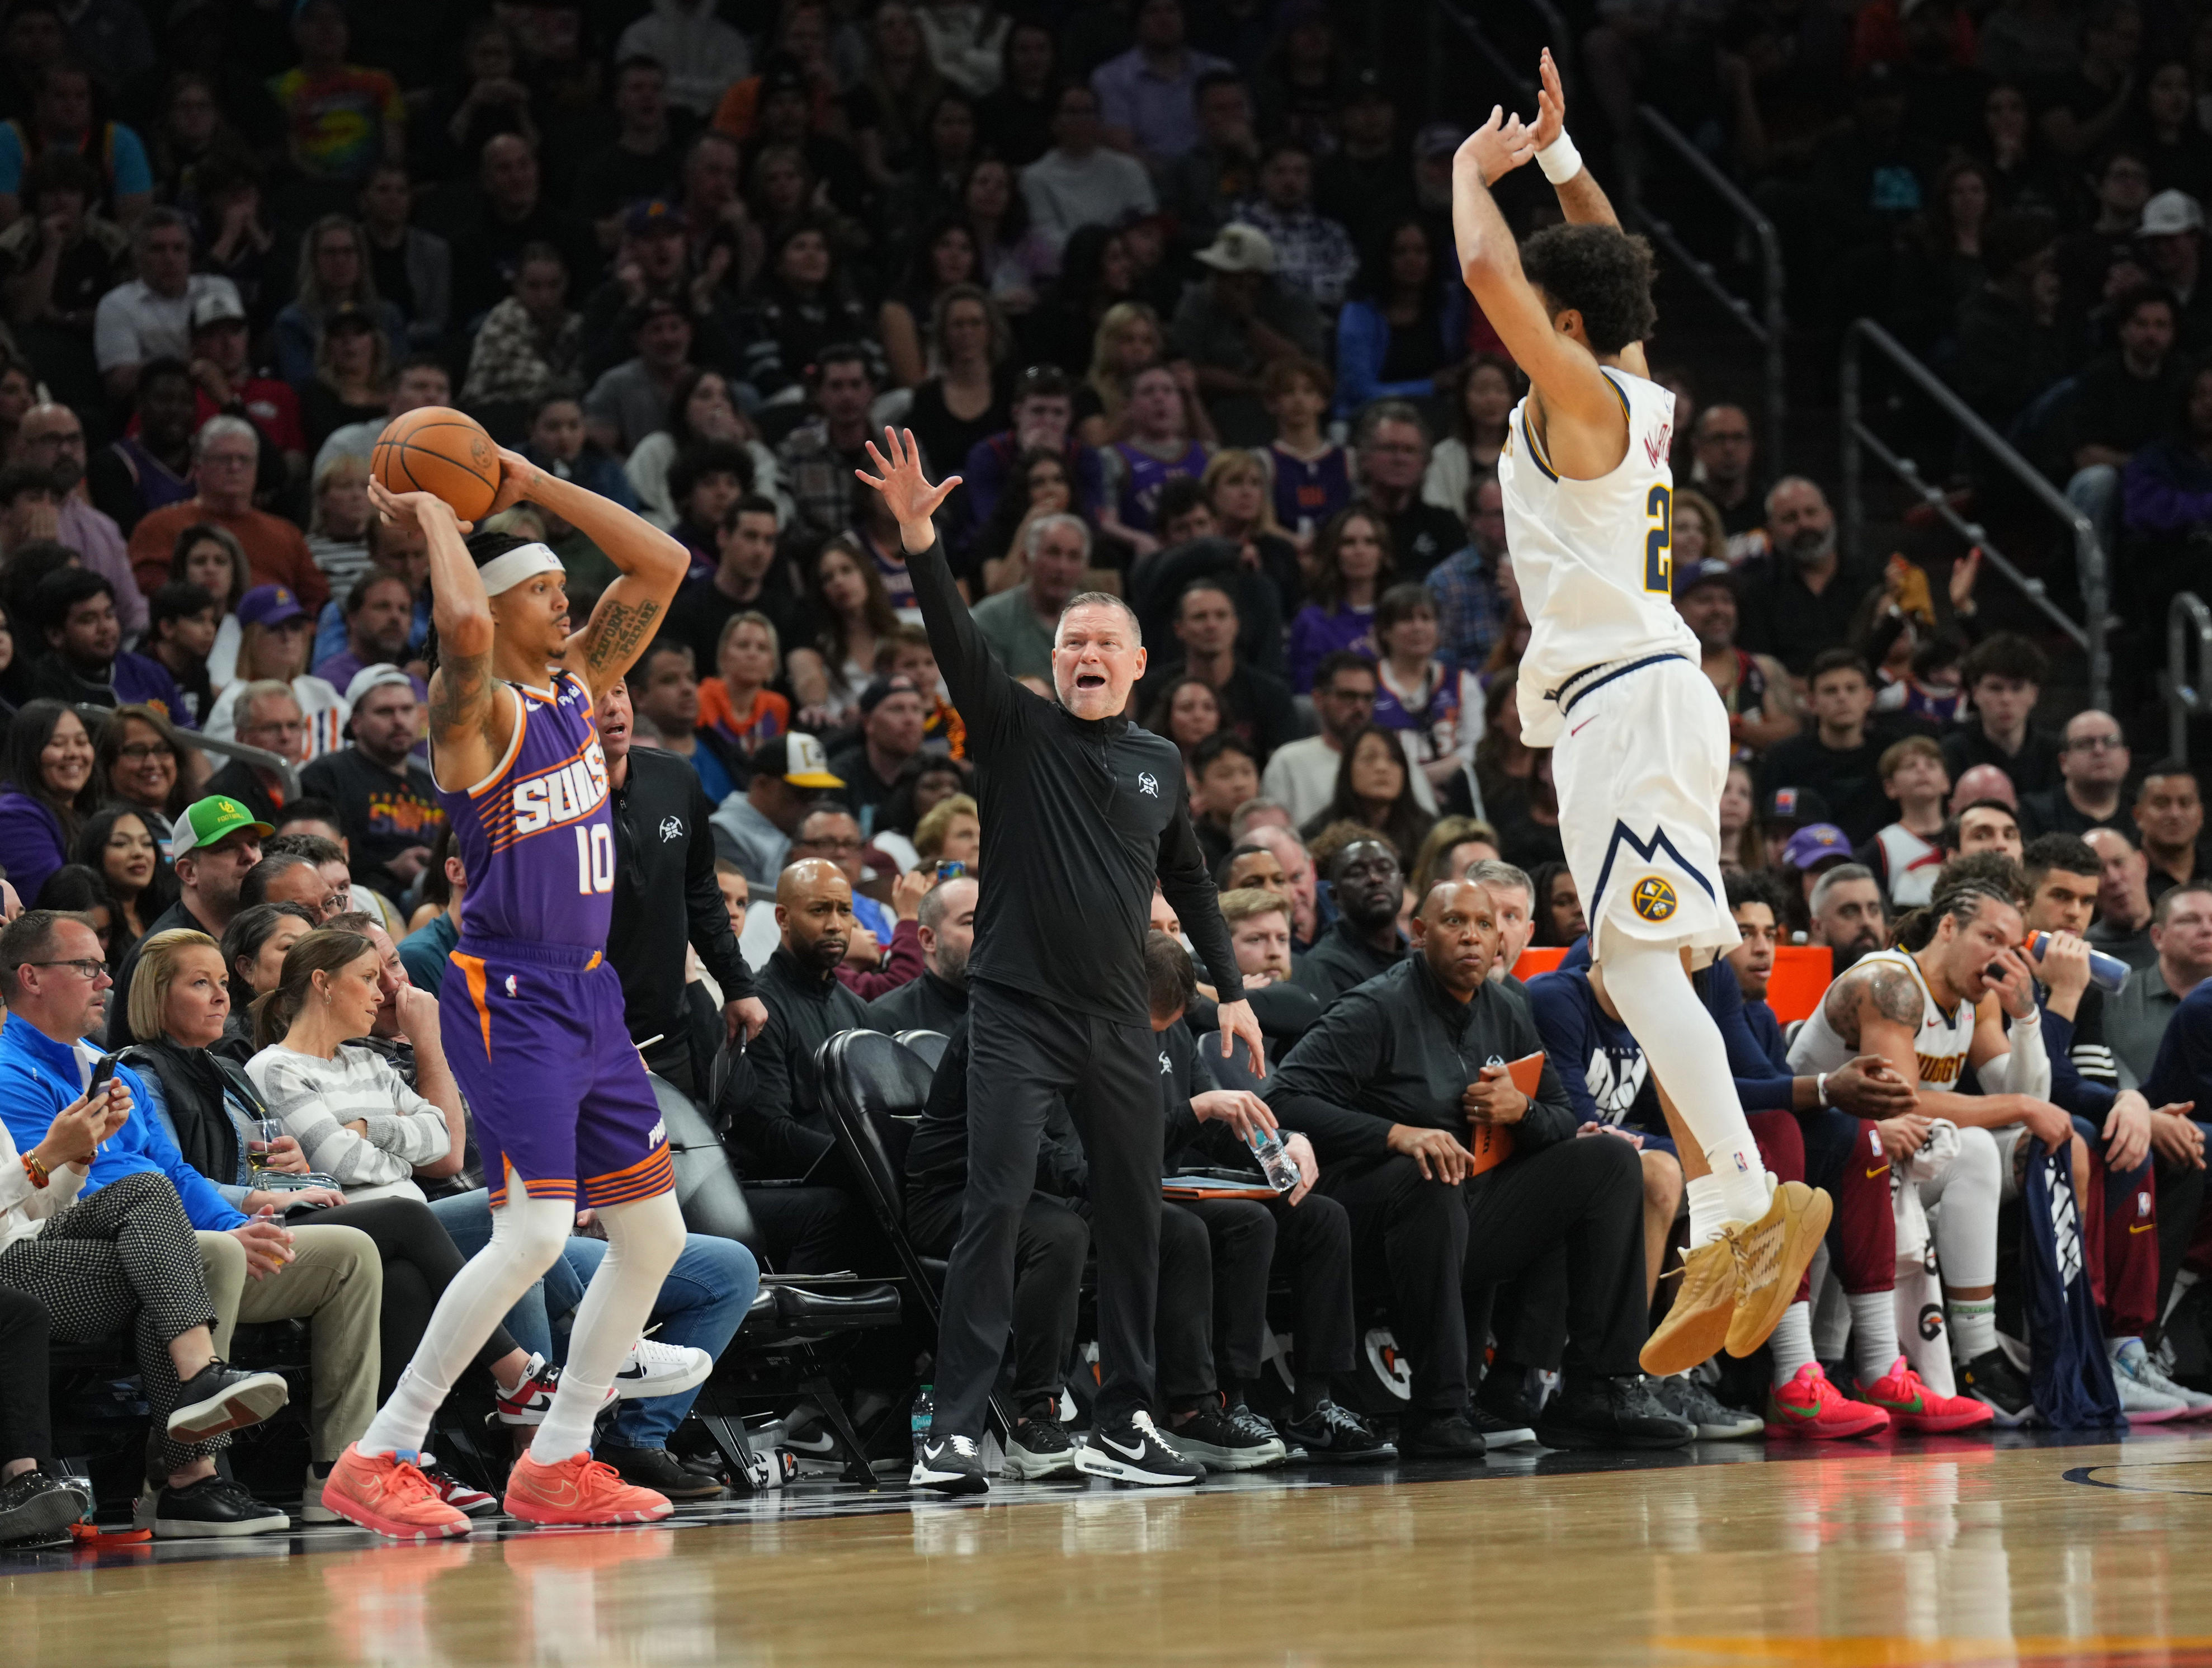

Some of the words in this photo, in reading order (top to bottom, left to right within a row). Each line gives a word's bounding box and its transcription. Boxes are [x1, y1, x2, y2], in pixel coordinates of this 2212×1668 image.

[1644, 482, 1672, 593] 2
[513, 742, 609, 834] SUNS
[574, 823, 615, 896] 10
